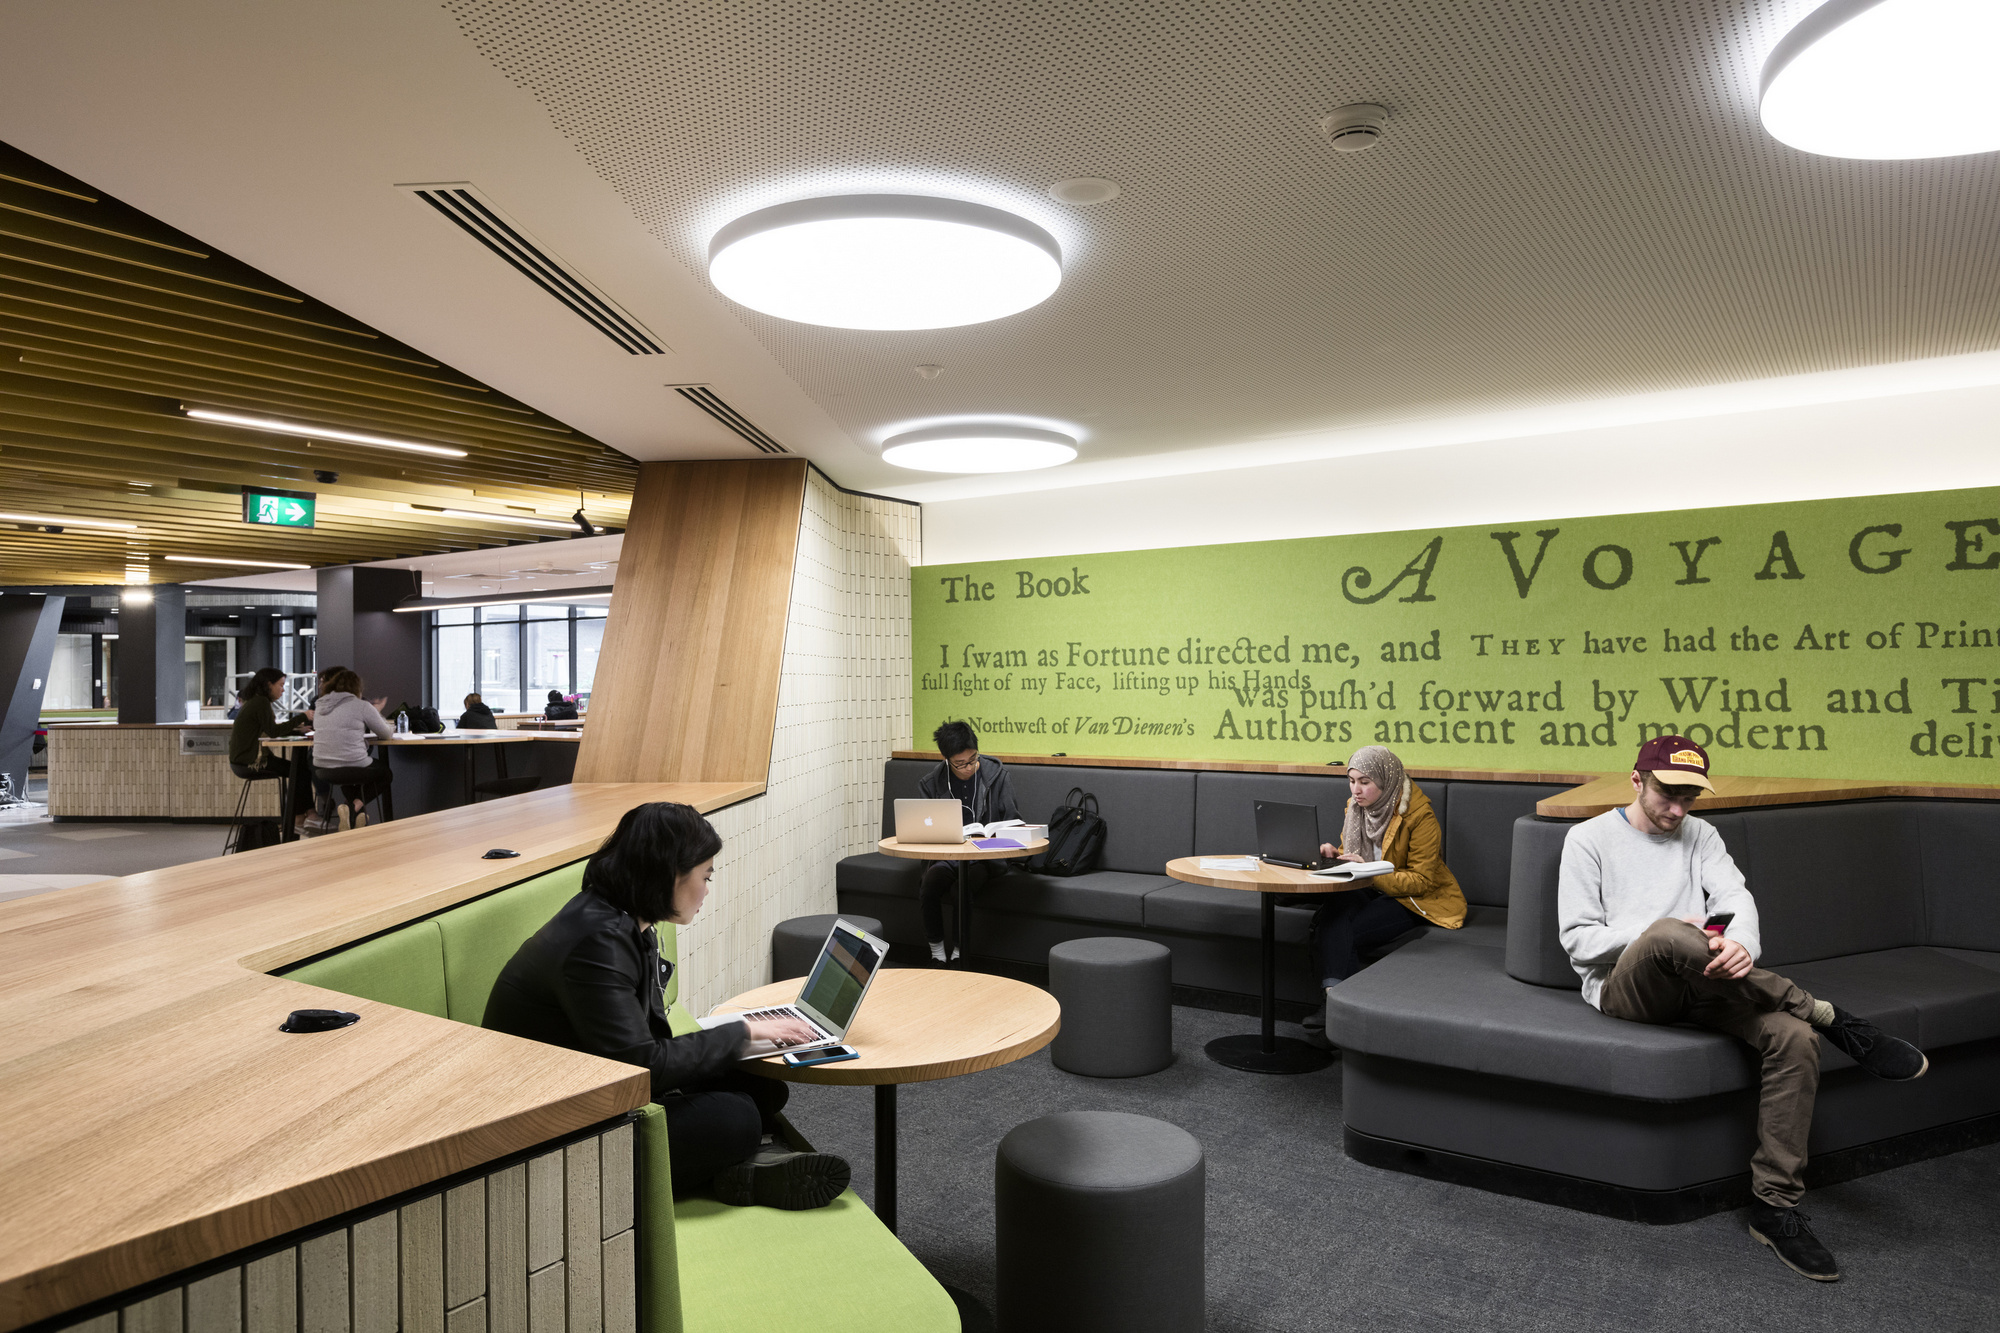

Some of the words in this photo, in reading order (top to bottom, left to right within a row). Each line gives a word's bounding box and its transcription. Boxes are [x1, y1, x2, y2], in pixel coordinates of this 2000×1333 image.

[1341, 536, 1443, 604] A
[1490, 518, 2000, 599] VOYAGE
[940, 574, 996, 603] The
[1015, 567, 1091, 599] Book
[940, 644, 949, 669] I
[1037, 649, 1059, 668] as
[1066, 641, 1170, 667] Fortune
[1177, 636, 1291, 665] directed
[1301, 642, 1360, 670] me,
[1380, 629, 1442, 664] and
[1470, 633, 1566, 657] THEY
[1583, 630, 1648, 655] have
[1663, 627, 1717, 653] had
[1730, 625, 1780, 652] the
[1794, 623, 1851, 651] Art
[1866, 621, 1906, 650] of
[921, 672, 949, 691] full
[993, 672, 1013, 691] of
[1021, 677, 1048, 696] my
[1055, 672, 1101, 694] Face,
[1113, 671, 1170, 697] lifting
[1176, 676, 1199, 697] up
[1208, 669, 1236, 690] his
[1243, 668, 1312, 691] Hands
[1418, 679, 1566, 713] forward
[1592, 679, 1639, 723] by
[1659, 676, 1793, 714] Wind
[1826, 677, 1913, 715] and
[1051, 717, 1071, 735] of
[1074, 716, 1110, 735] Van
[1213, 708, 1353, 744] Authors
[1373, 711, 1515, 745] ancient
[1539, 713, 1617, 748] and
[1637, 712, 1829, 752] modern
[1909, 718, 2000, 761] deli
